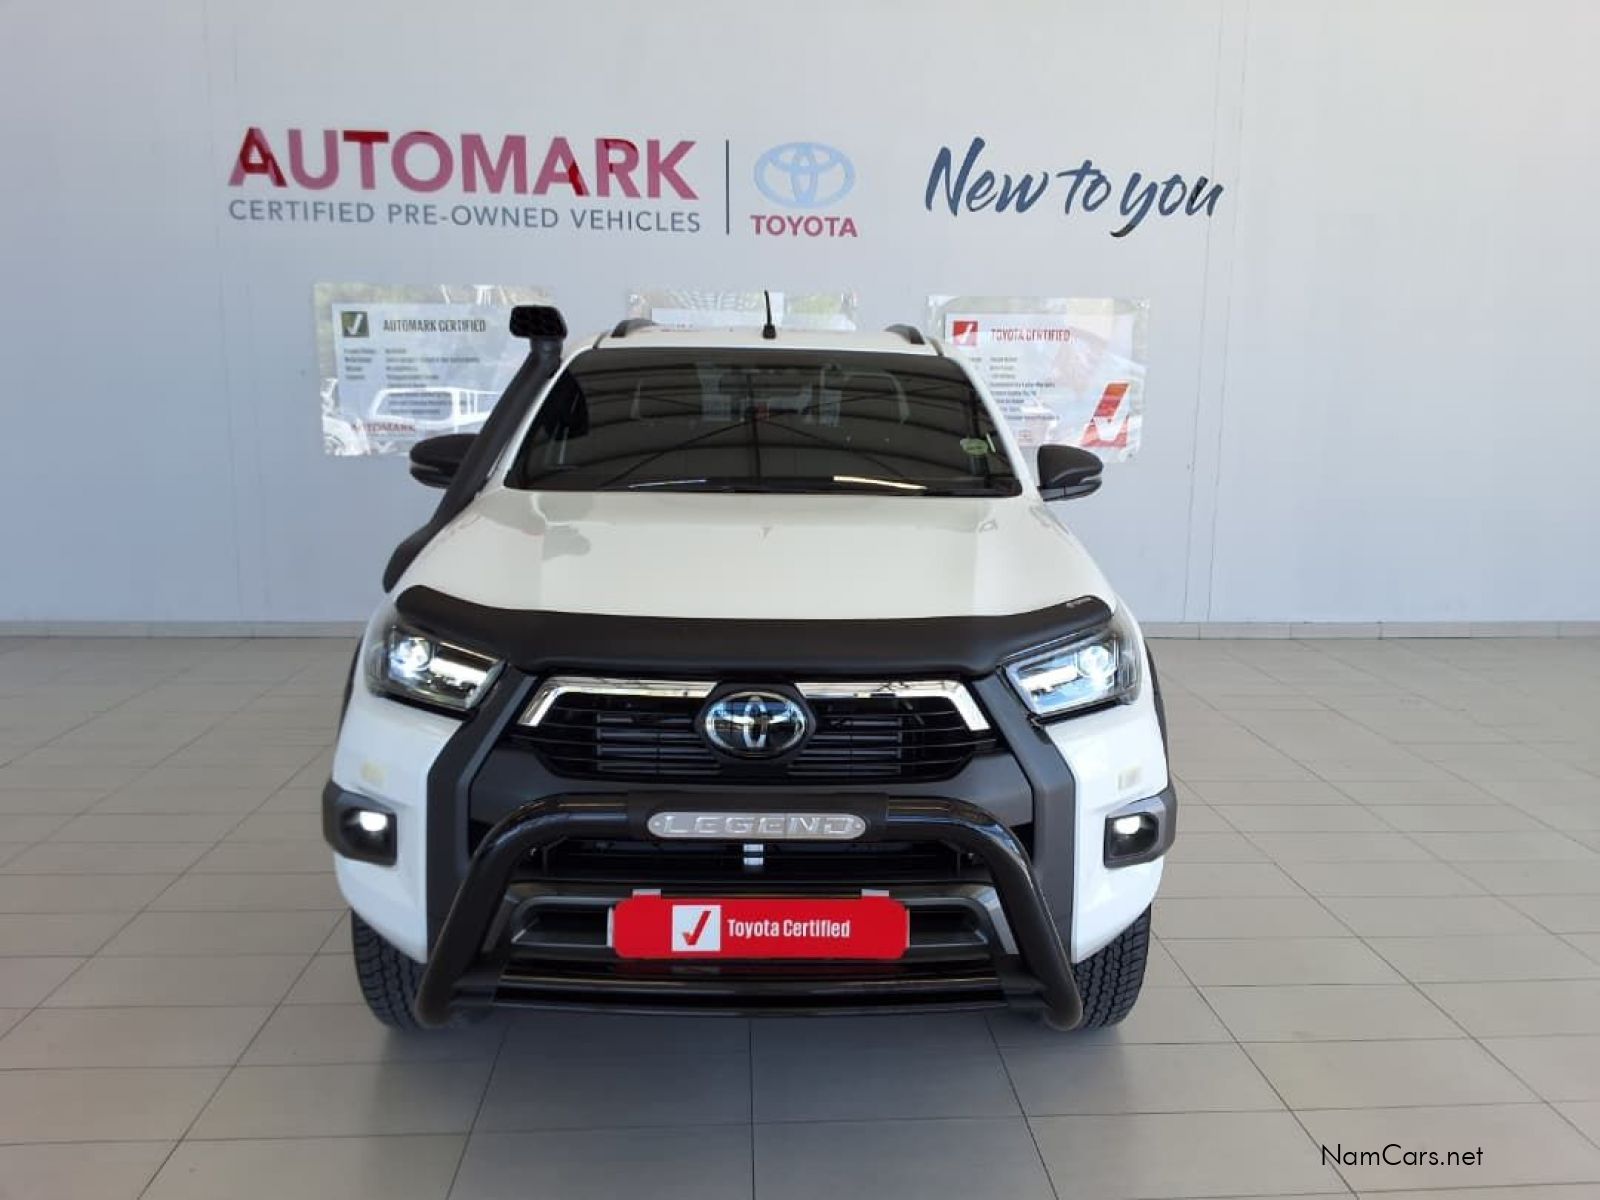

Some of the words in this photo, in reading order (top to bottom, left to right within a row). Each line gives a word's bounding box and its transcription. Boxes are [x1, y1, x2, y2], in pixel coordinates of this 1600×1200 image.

[228, 127, 699, 200] AUTOMARK
[925, 136, 1049, 217] New
[1056, 158, 1112, 215] to
[1109, 171, 1224, 238] you
[228, 199, 375, 223] CERTIFIED
[388, 203, 559, 228] PRE-OWNED
[569, 208, 701, 233] VEHICLES
[750, 214, 858, 238] TOYOTA
[383, 319, 436, 333] AUTOMARK
[438, 319, 487, 333] CERTIFIED
[662, 816, 855, 834] LEGEND
[727, 918, 780, 939] Toyota
[783, 918, 851, 938] Certified
